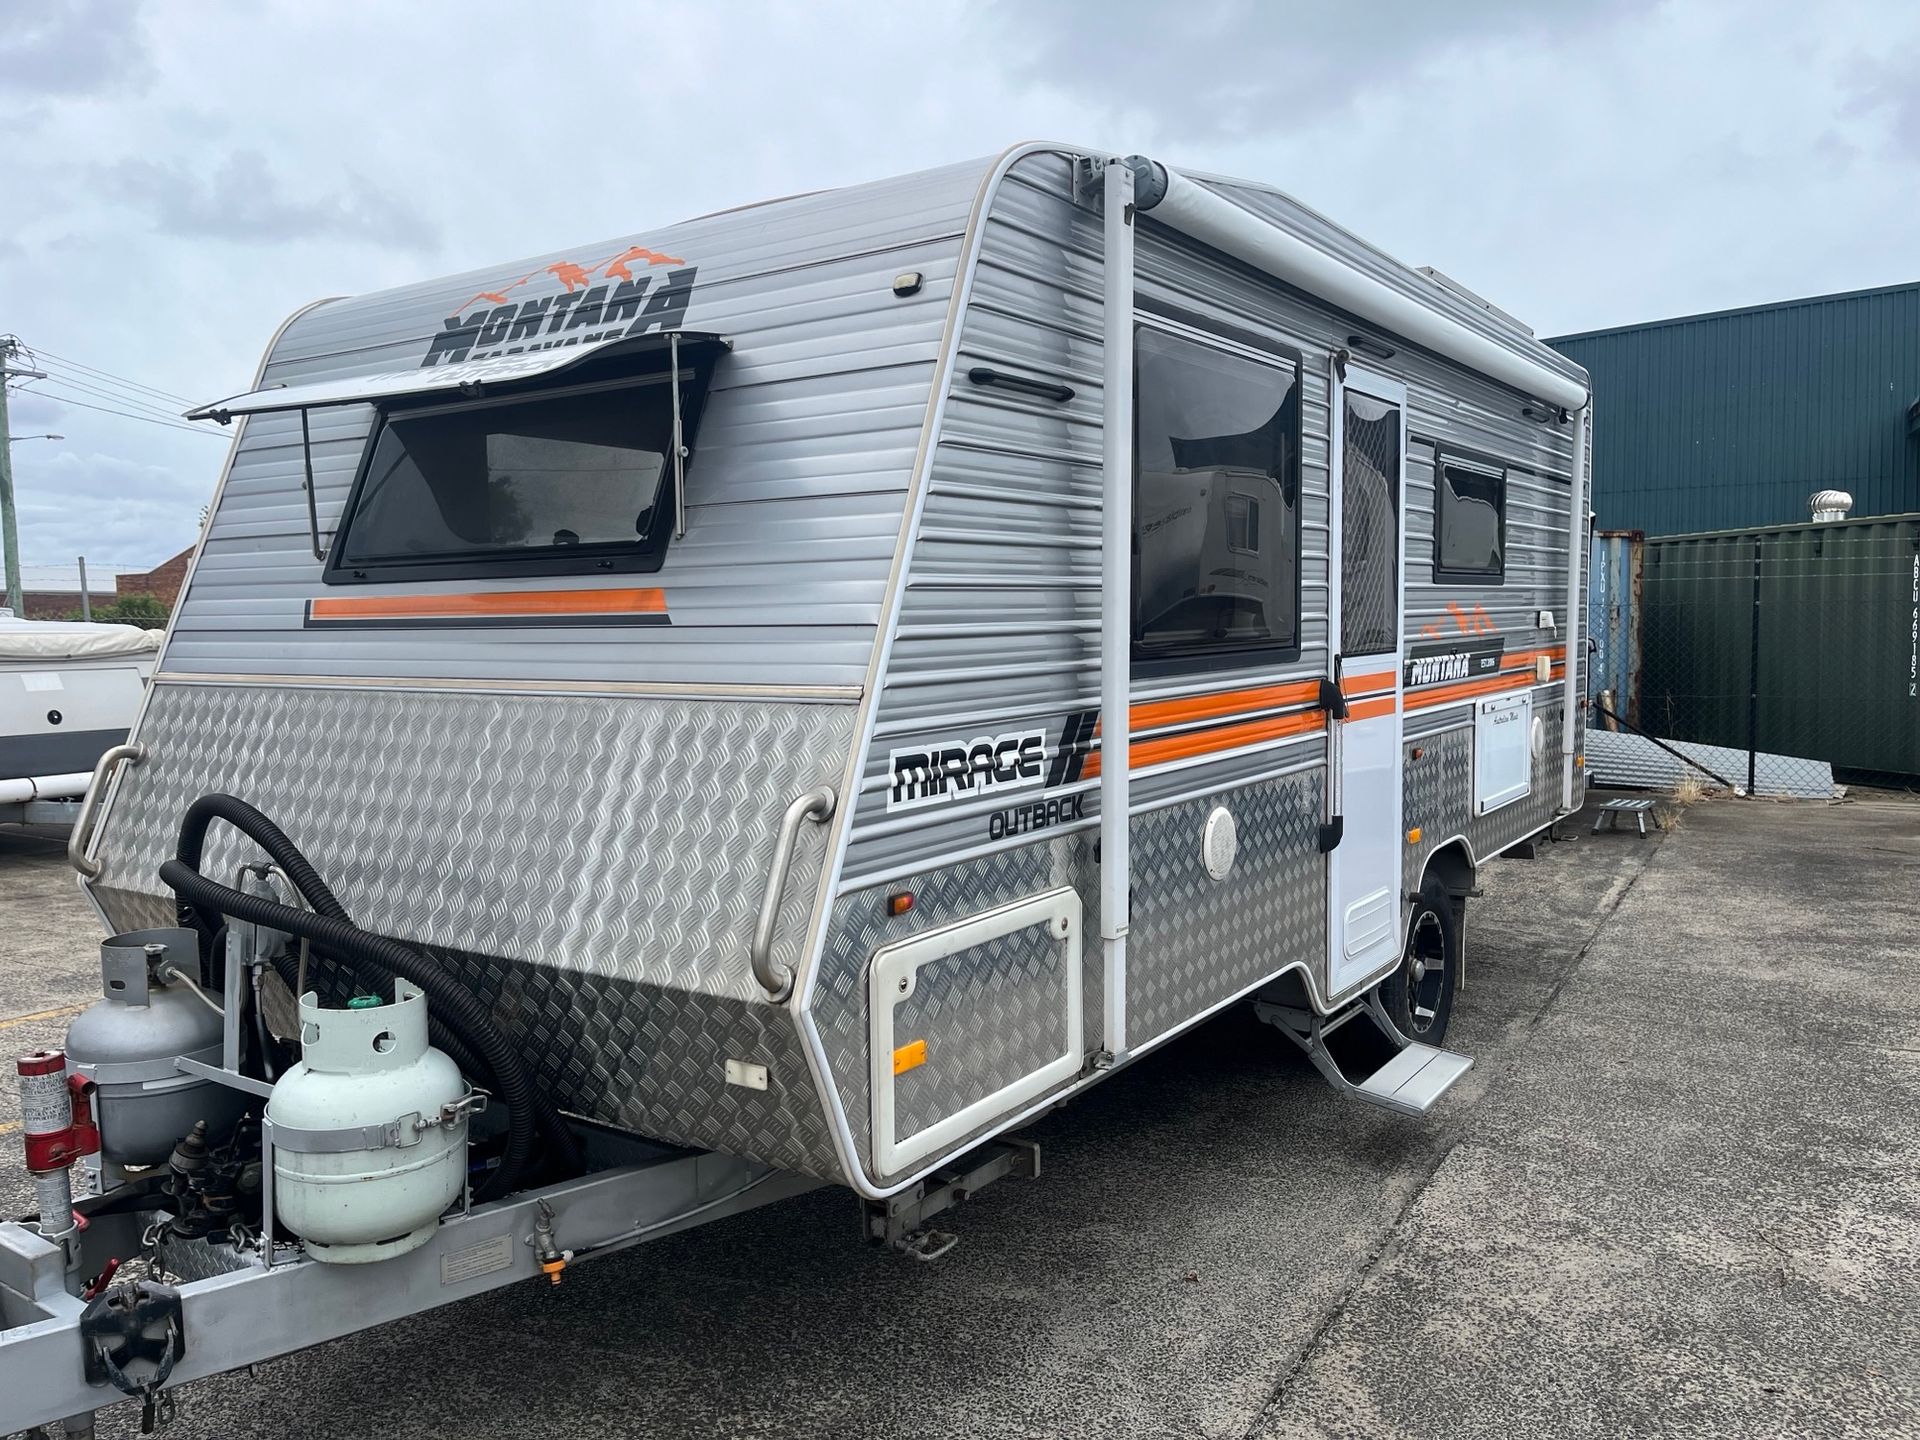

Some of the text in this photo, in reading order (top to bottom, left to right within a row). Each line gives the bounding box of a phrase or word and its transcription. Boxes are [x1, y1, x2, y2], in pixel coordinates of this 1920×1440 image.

[420, 266, 698, 367] MONTANA
[1909, 553, 1920, 697] ABCU 669185 2
[1404, 653, 1470, 685] MONTANA
[891, 734, 1044, 804] MIRAGE
[989, 794, 1084, 841] OUTBACK
